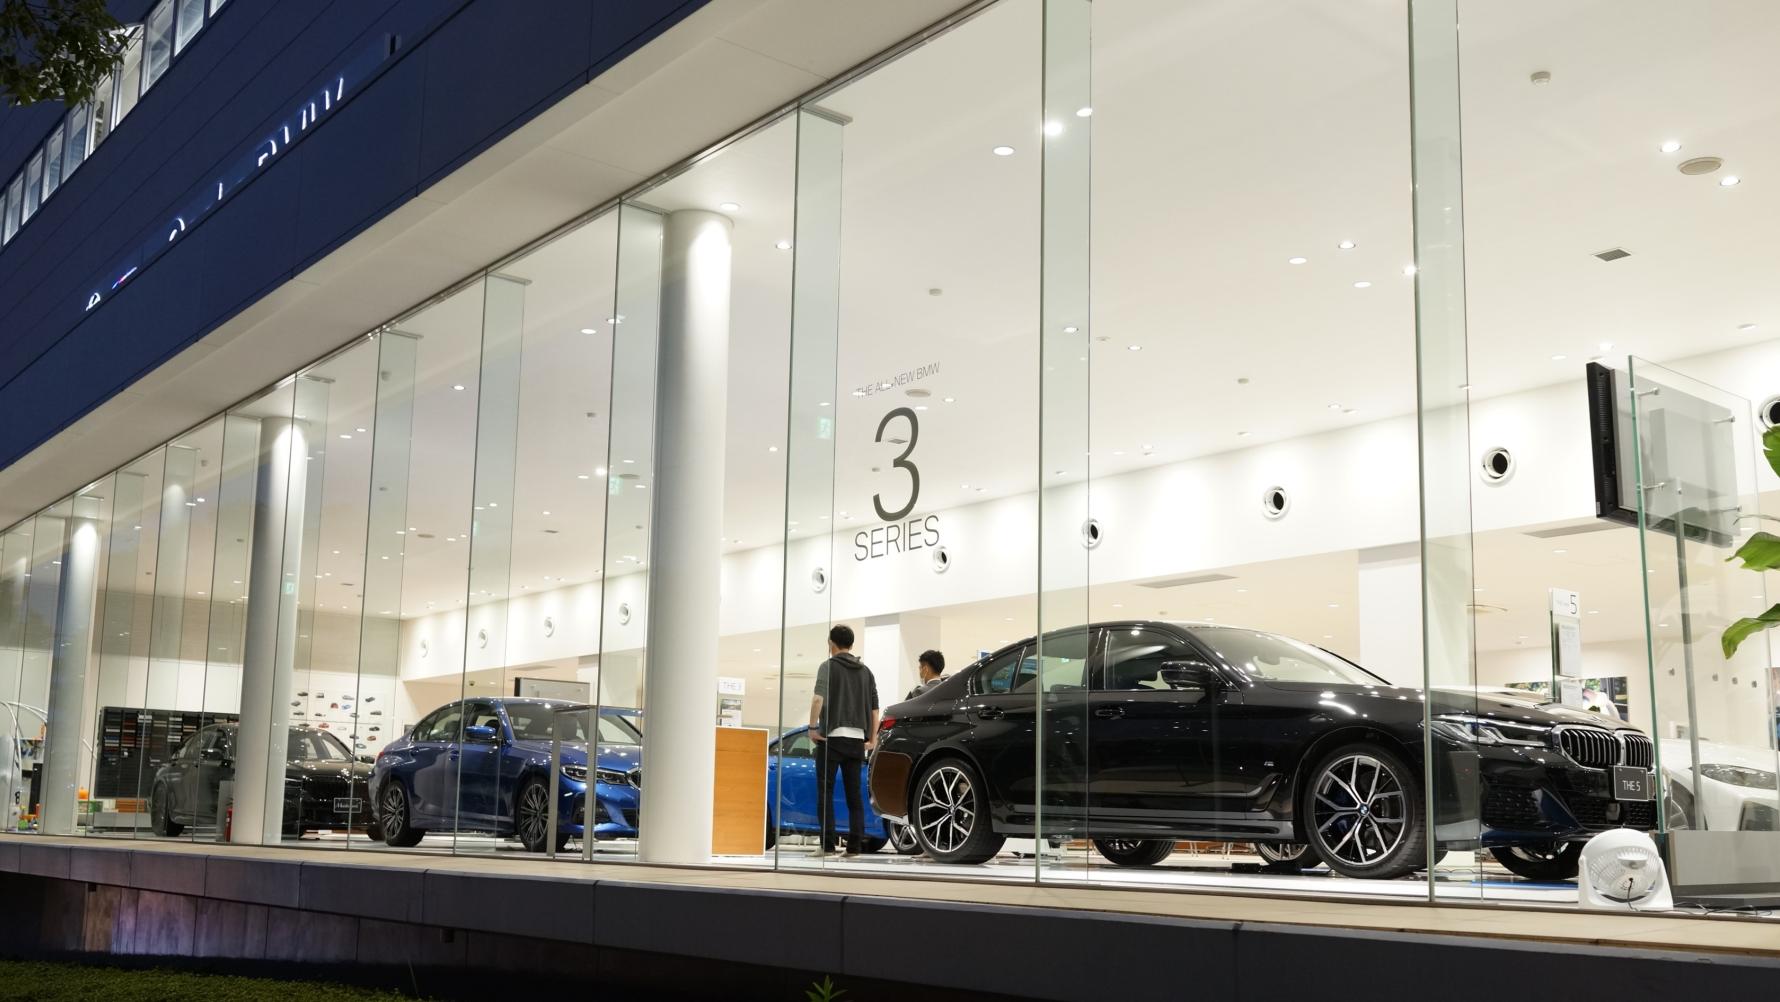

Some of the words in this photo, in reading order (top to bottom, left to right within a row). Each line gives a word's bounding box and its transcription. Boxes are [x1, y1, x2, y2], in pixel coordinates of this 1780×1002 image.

[855, 384, 873, 399] THE
[916, 361, 940, 380] BMW
[873, 407, 920, 522] 3
[854, 514, 940, 561] SERIES
[1569, 594, 1578, 615] 5
[1622, 780, 1635, 791] THE
